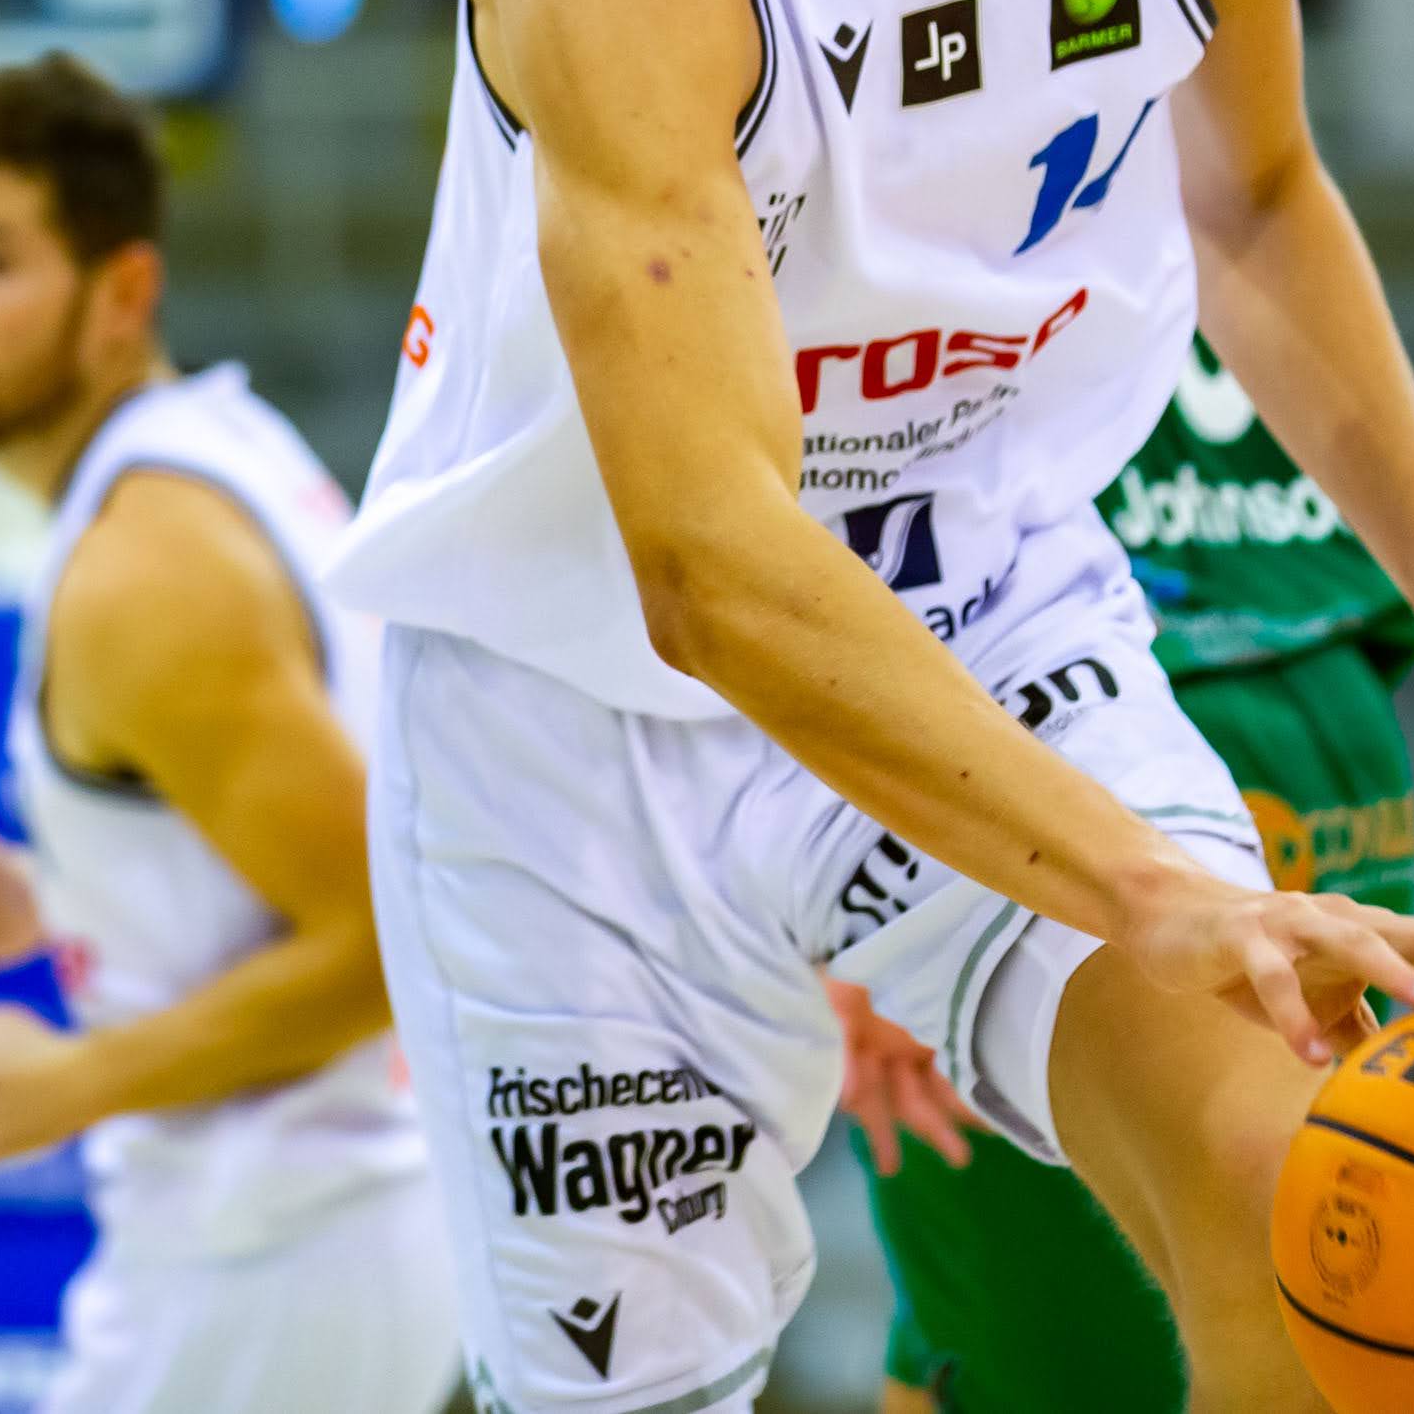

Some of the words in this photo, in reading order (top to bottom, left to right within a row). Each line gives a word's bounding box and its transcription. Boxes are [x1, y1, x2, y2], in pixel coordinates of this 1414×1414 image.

[1055, 23, 1133, 59] BARMER
[1113, 464, 1354, 548] Johnso
[490, 1122, 756, 1223] Wagner
